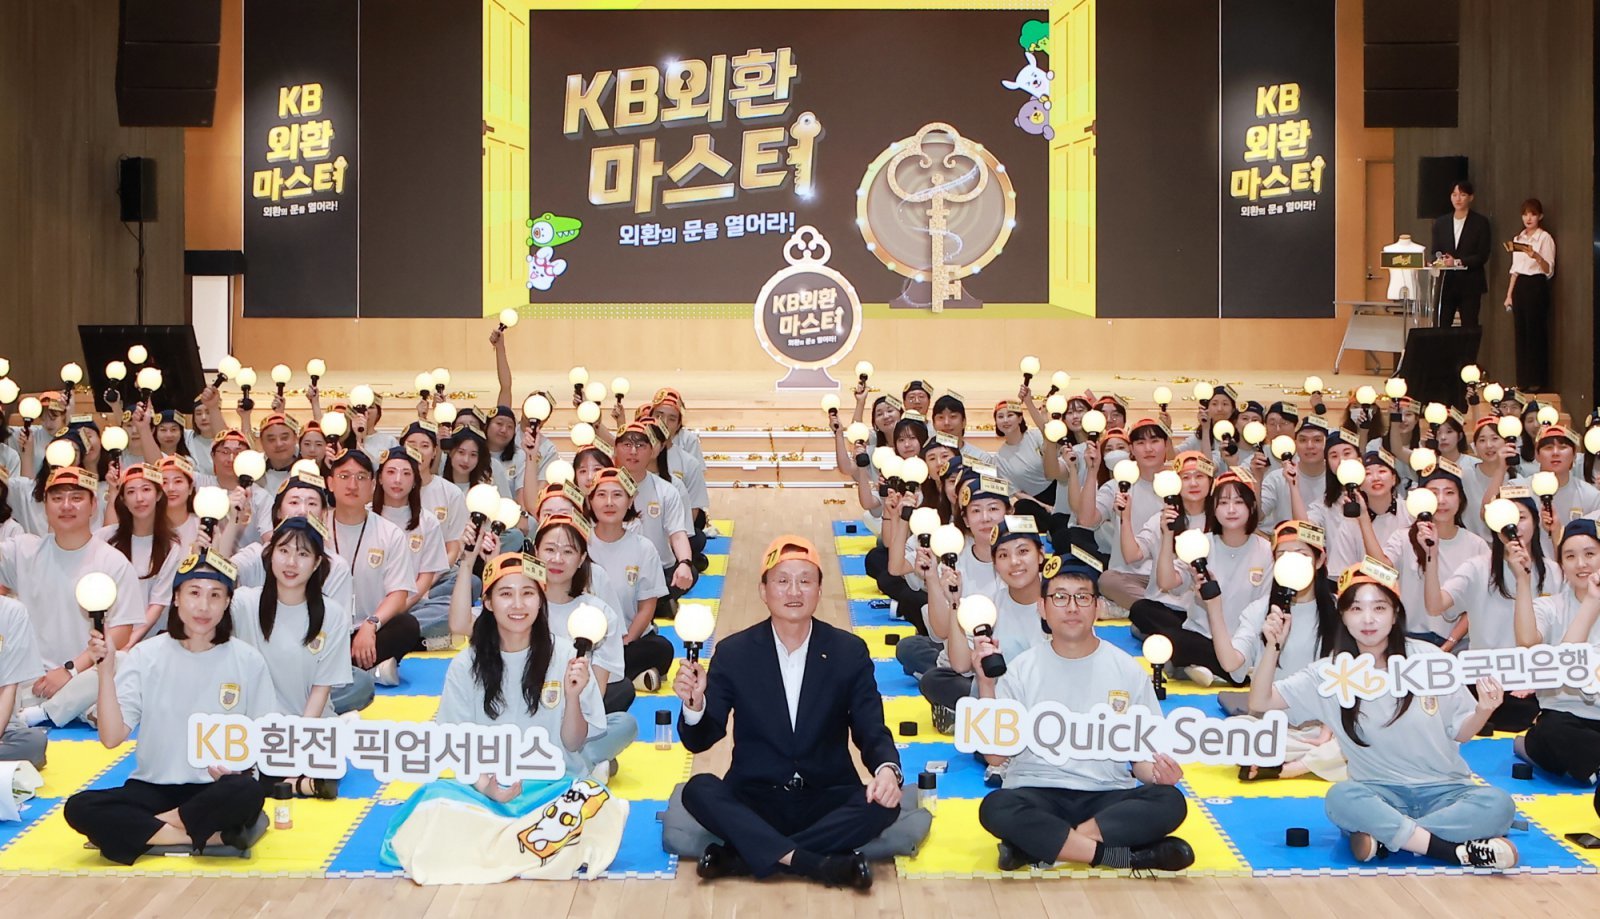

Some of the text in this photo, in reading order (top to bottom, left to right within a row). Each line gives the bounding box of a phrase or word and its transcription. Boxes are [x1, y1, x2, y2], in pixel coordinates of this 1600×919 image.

[278, 83, 323, 118] KB
[563, 47, 799, 137] KB외환
[1256, 82, 1300, 117] KB
[266, 120, 335, 162] 외환
[1244, 119, 1312, 162] 외환
[252, 156, 348, 201] 마스터
[588, 111, 823, 214] 마스터
[1230, 155, 1326, 201] 마스터
[619, 212, 796, 246] 외환의 문을 열어라!
[772, 287, 837, 314] KB외환
[779, 306, 845, 337] 마스터
[1045, 558, 1059, 576] 96
[195, 722, 556, 776] KB 환전 픽업서비스
[963, 707, 1279, 758] KB Quick Send
